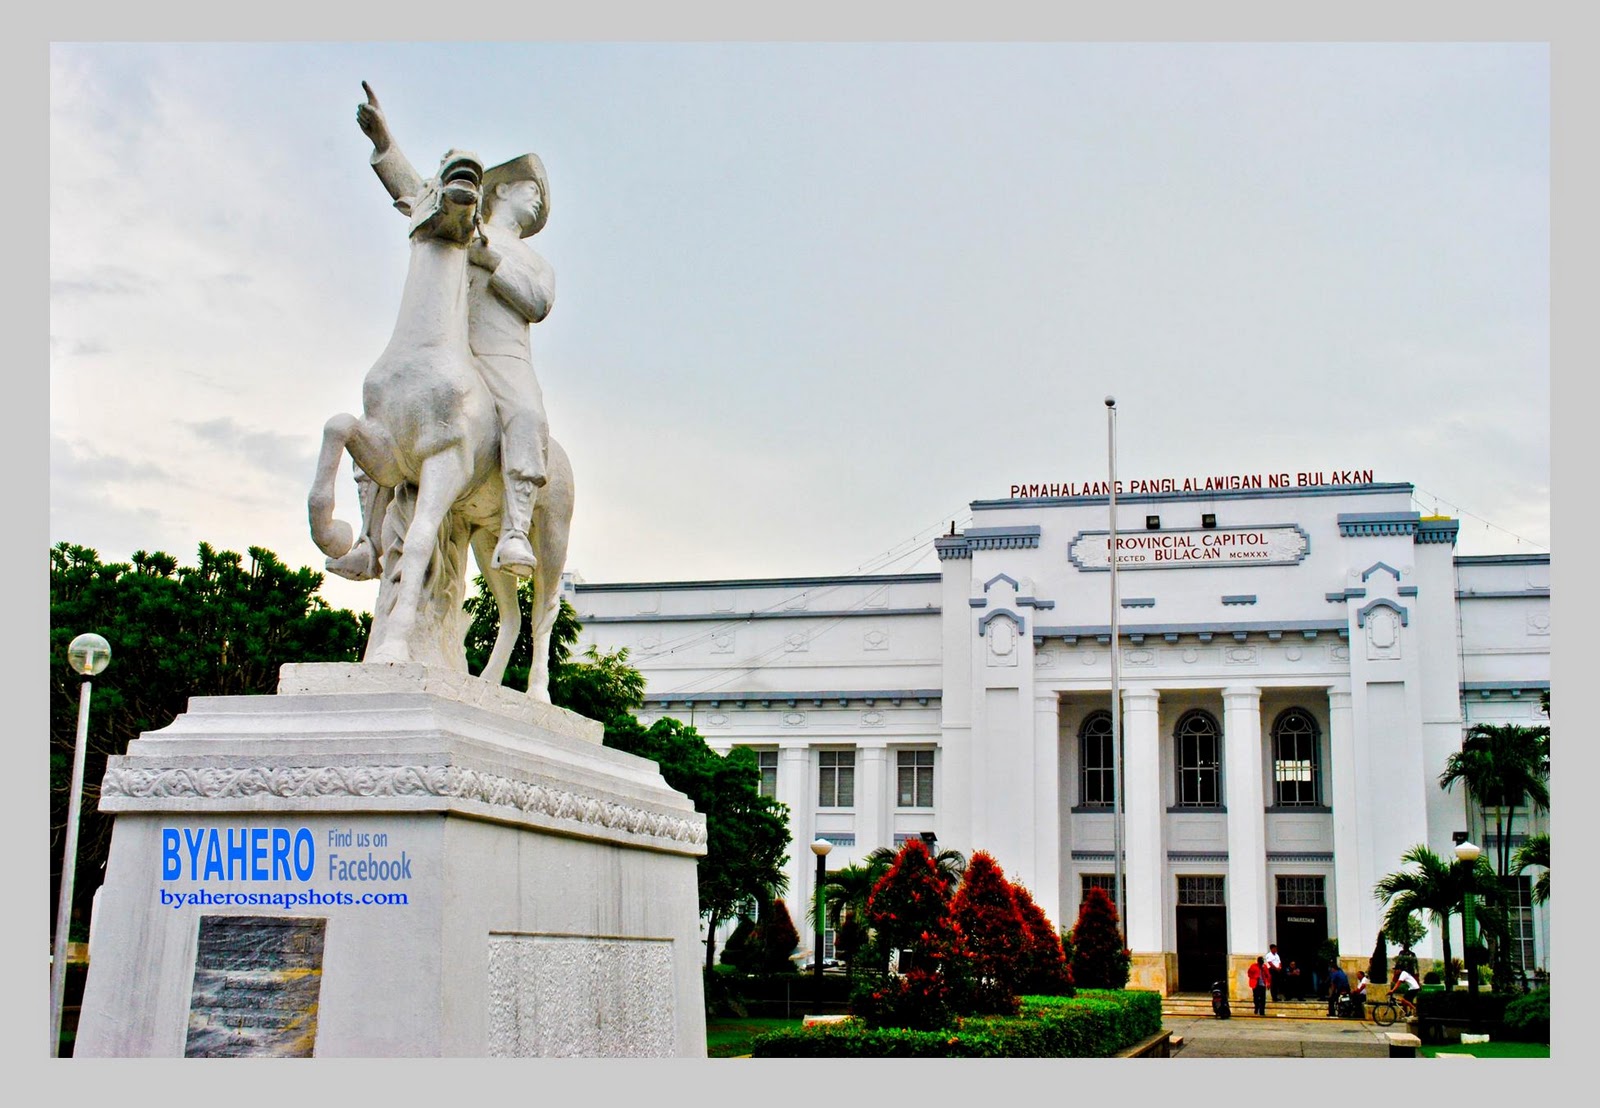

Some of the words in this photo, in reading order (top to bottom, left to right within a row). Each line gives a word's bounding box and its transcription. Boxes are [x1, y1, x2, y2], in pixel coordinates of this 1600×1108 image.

[1010, 481, 1122, 499] PAMAHALAANG
[1130, 475, 1261, 493] PANGLALAWIGAN
[1269, 473, 1290, 489] NG
[1297, 470, 1374, 487] BULAKAN
[1202, 533, 1269, 546] CAPITOL
[1107, 555, 1146, 563] EECTED
[1155, 547, 1220, 561] BULACAN
[1229, 551, 1268, 559] MCMXXX
